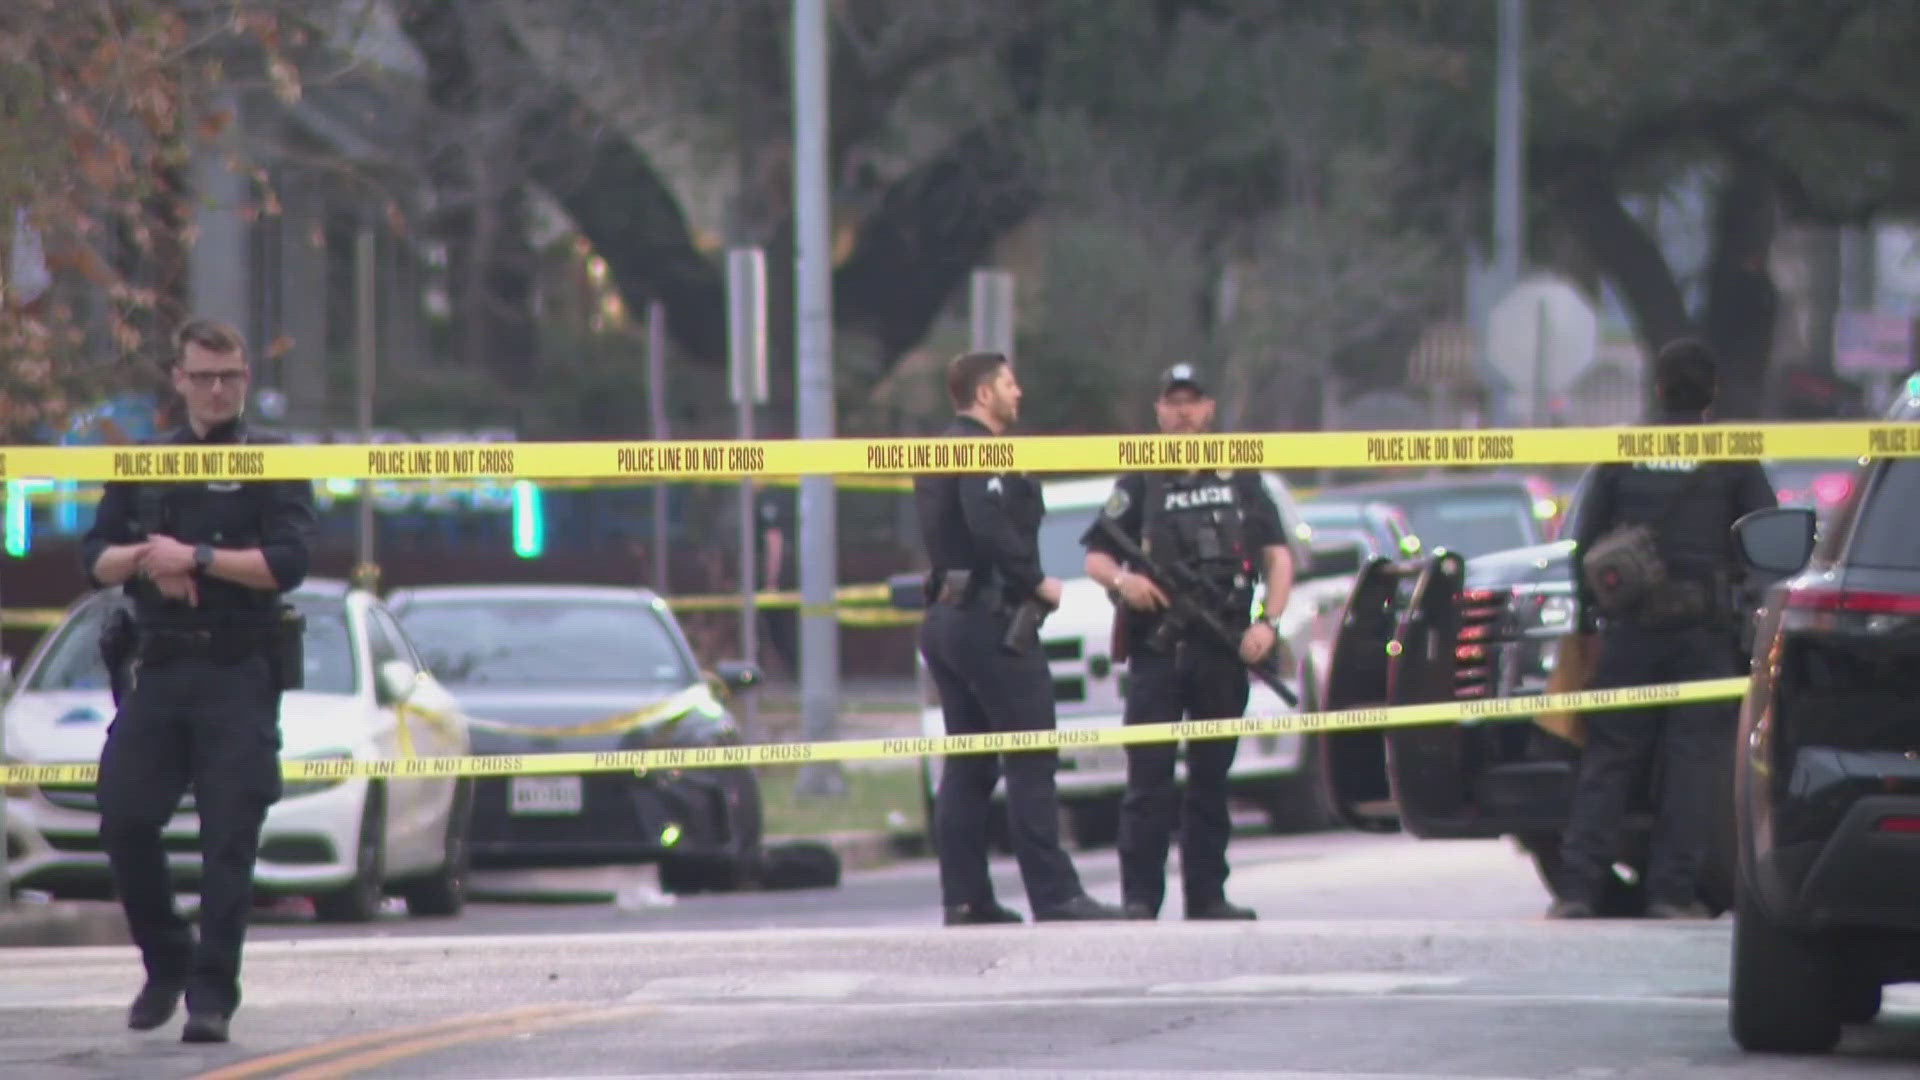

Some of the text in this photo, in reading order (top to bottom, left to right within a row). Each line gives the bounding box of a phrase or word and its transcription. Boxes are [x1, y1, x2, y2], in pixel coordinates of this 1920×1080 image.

[1367, 437, 1513, 461] POLICE LINE DO NOT CROSS
[1617, 431, 1763, 456] POLICE LINE DO NOT CROSS
[1868, 428, 1907, 452] POLICE
[368, 451, 514, 474] POLICE LINE DO NOT CROSS
[618, 447, 764, 471] POLICE LINE DO NOT CROSS
[867, 444, 1014, 469] POLICE LINE DO NOT CROSS
[1119, 440, 1264, 464] POLICE LINE DO NOT CROSS
[114, 453, 265, 475] POLICE LINE DO NOT CROSS
[1171, 722, 1224, 737] POLICE
[1230, 719, 1264, 733] LINE
[1272, 717, 1292, 730] DO
[1301, 714, 1328, 728] NOT
[883, 739, 936, 754] POLICE
[943, 736, 976, 750] LINE
[984, 734, 1004, 748] DO
[1011, 732, 1041, 747] NOT
[304, 761, 356, 776] POLICE
[366, 760, 397, 774] LINE
[406, 760, 427, 774] DO
[433, 758, 463, 773] NOT
[595, 751, 648, 767] POLICE
[655, 750, 689, 765] LINE
[696, 749, 716, 763] DO
[723, 747, 753, 761] NOT
[8, 766, 98, 782] POLICE LIN
